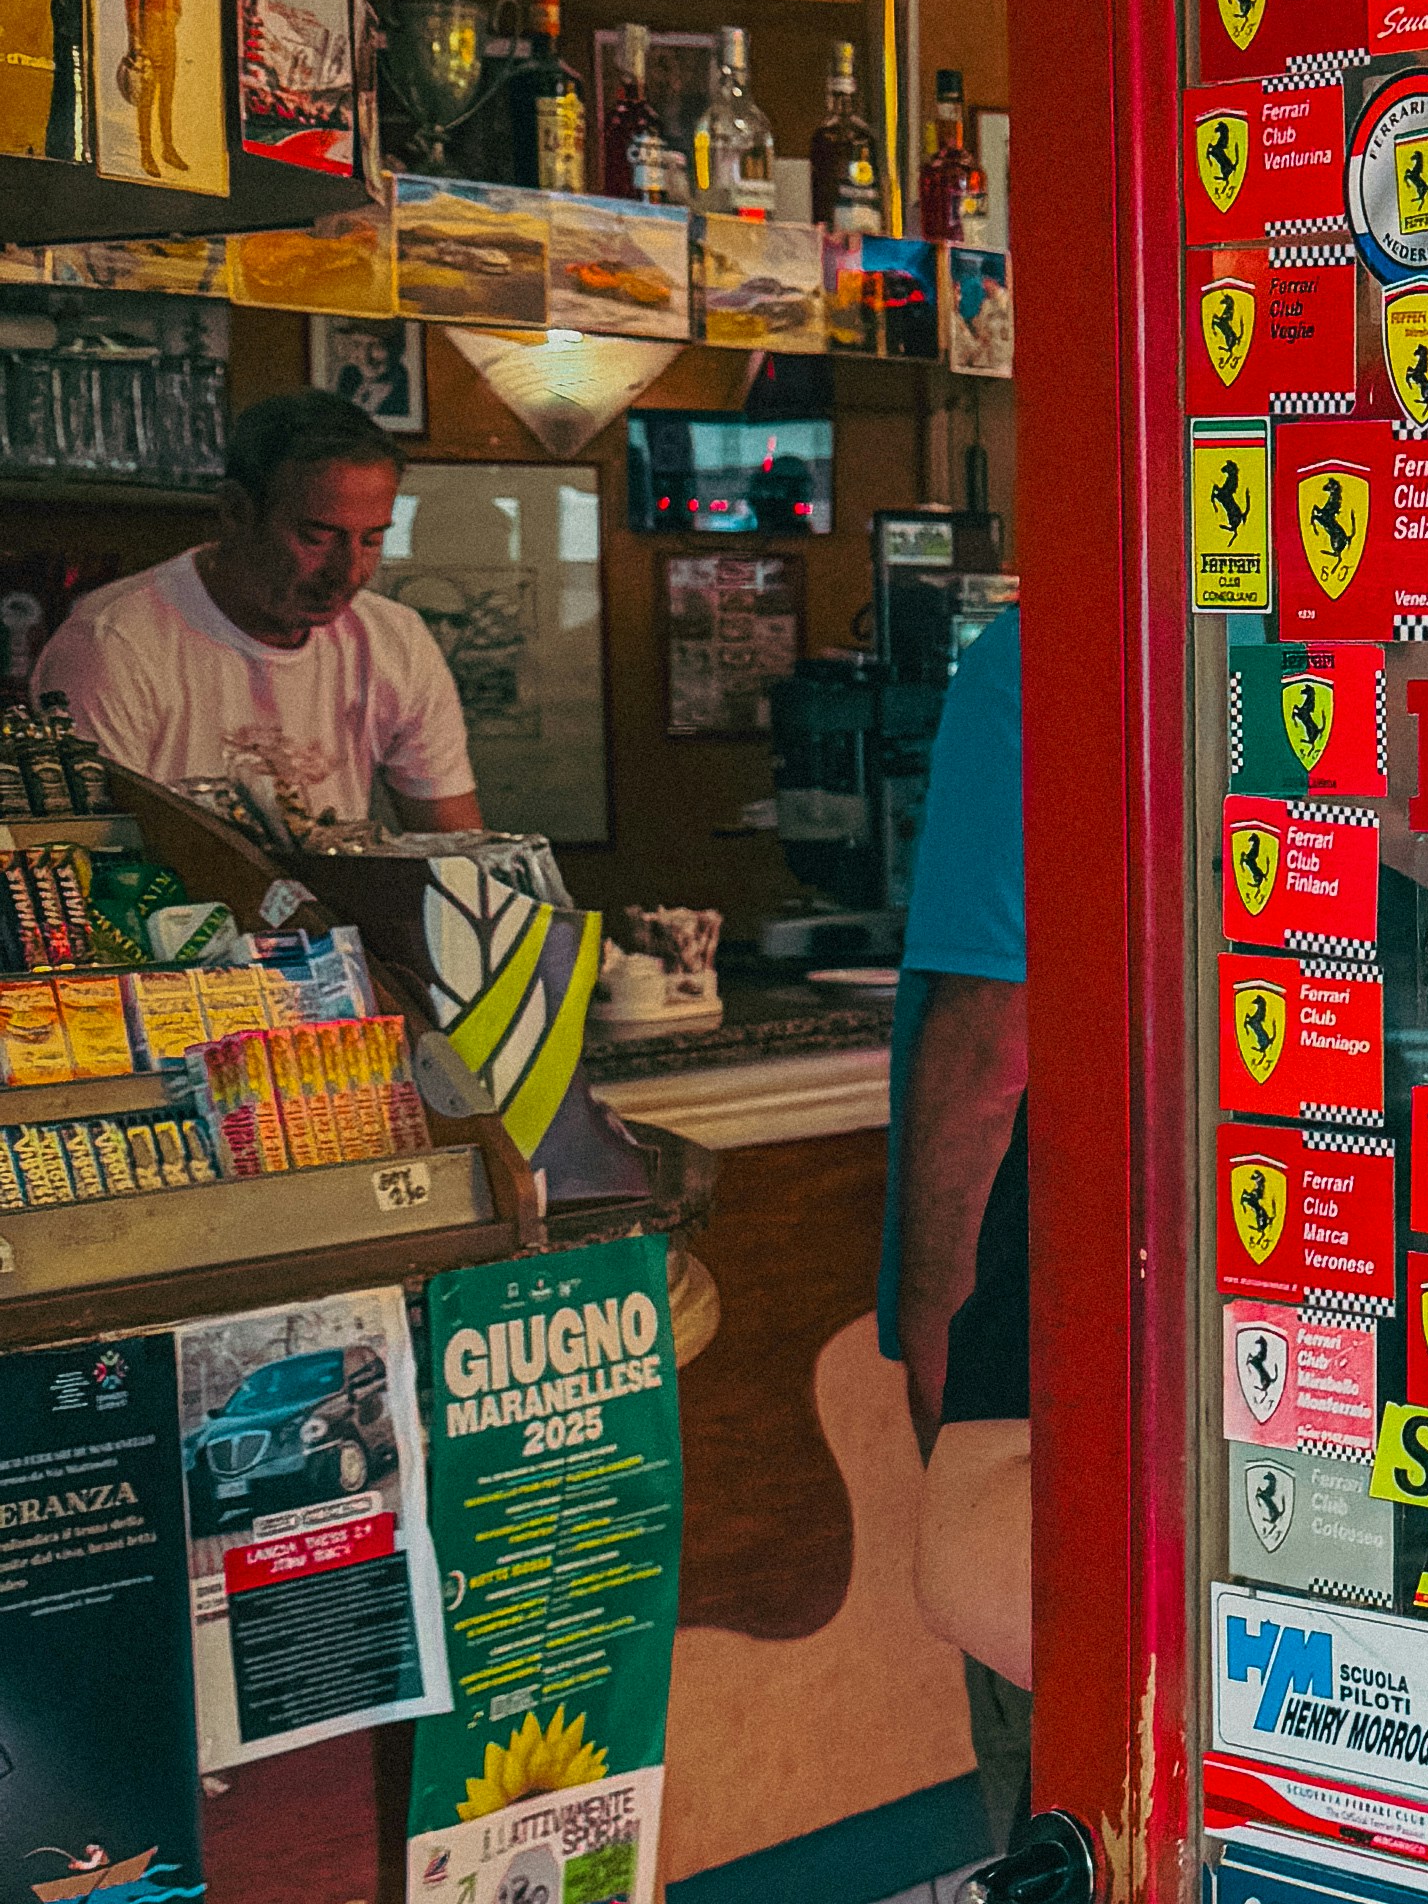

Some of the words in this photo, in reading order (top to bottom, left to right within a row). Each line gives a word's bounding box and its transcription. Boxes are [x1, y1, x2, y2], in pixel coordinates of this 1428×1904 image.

[444, 1293, 659, 1397] GIUGNO
[446, 1357, 661, 1438] MARANELLESE
[522, 1408, 604, 1457] 2025
[1339, 1665, 1409, 1694] SCUOLA
[1339, 1686, 1411, 1716] PILOTI
[1282, 1697, 1348, 1745] HENRY
